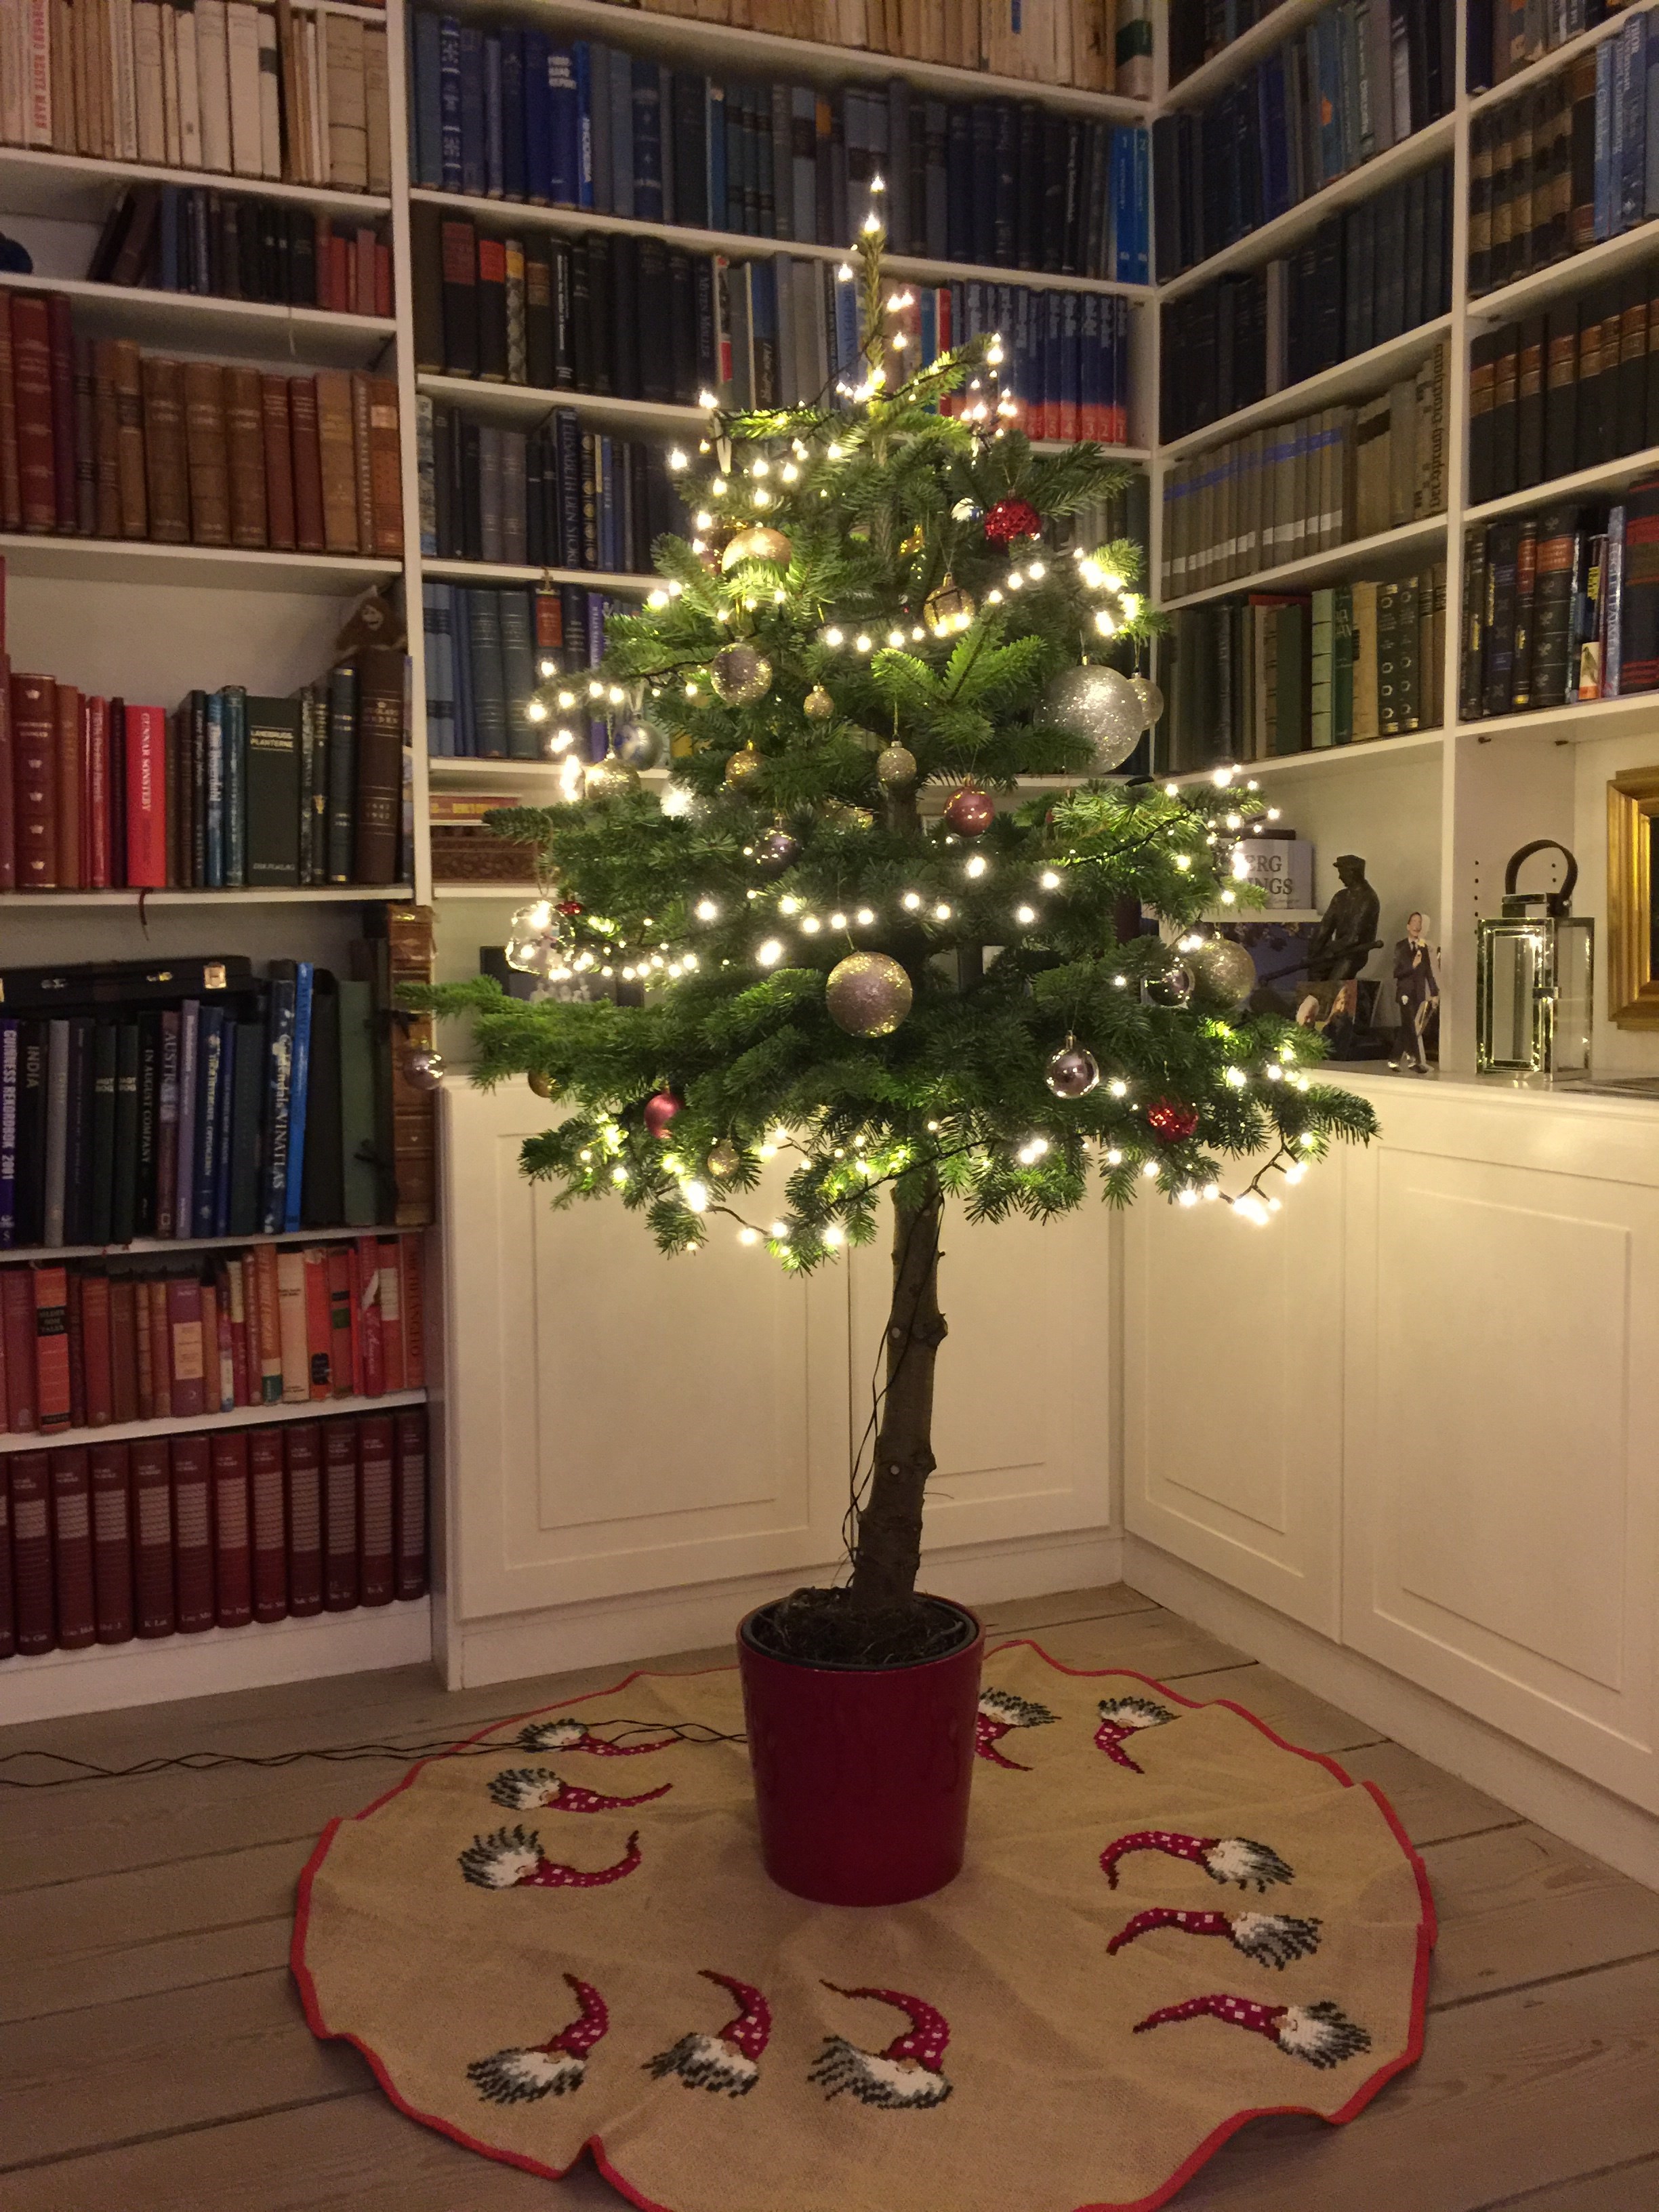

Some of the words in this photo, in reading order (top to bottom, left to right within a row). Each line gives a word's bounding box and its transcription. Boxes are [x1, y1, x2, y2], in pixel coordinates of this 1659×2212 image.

[141, 713, 150, 756] GUNNAR
[3, 1029, 17, 1083] GUINNESS
[26, 1046, 40, 1088] INDIA
[144, 1049, 154, 1063] IN
[143, 1065, 152, 1107] AUGUST
[142, 1109, 152, 1163] COMPANY
[272, 1113, 287, 1189] VINATLAS
[1, 1154, 15, 1180] 2001
